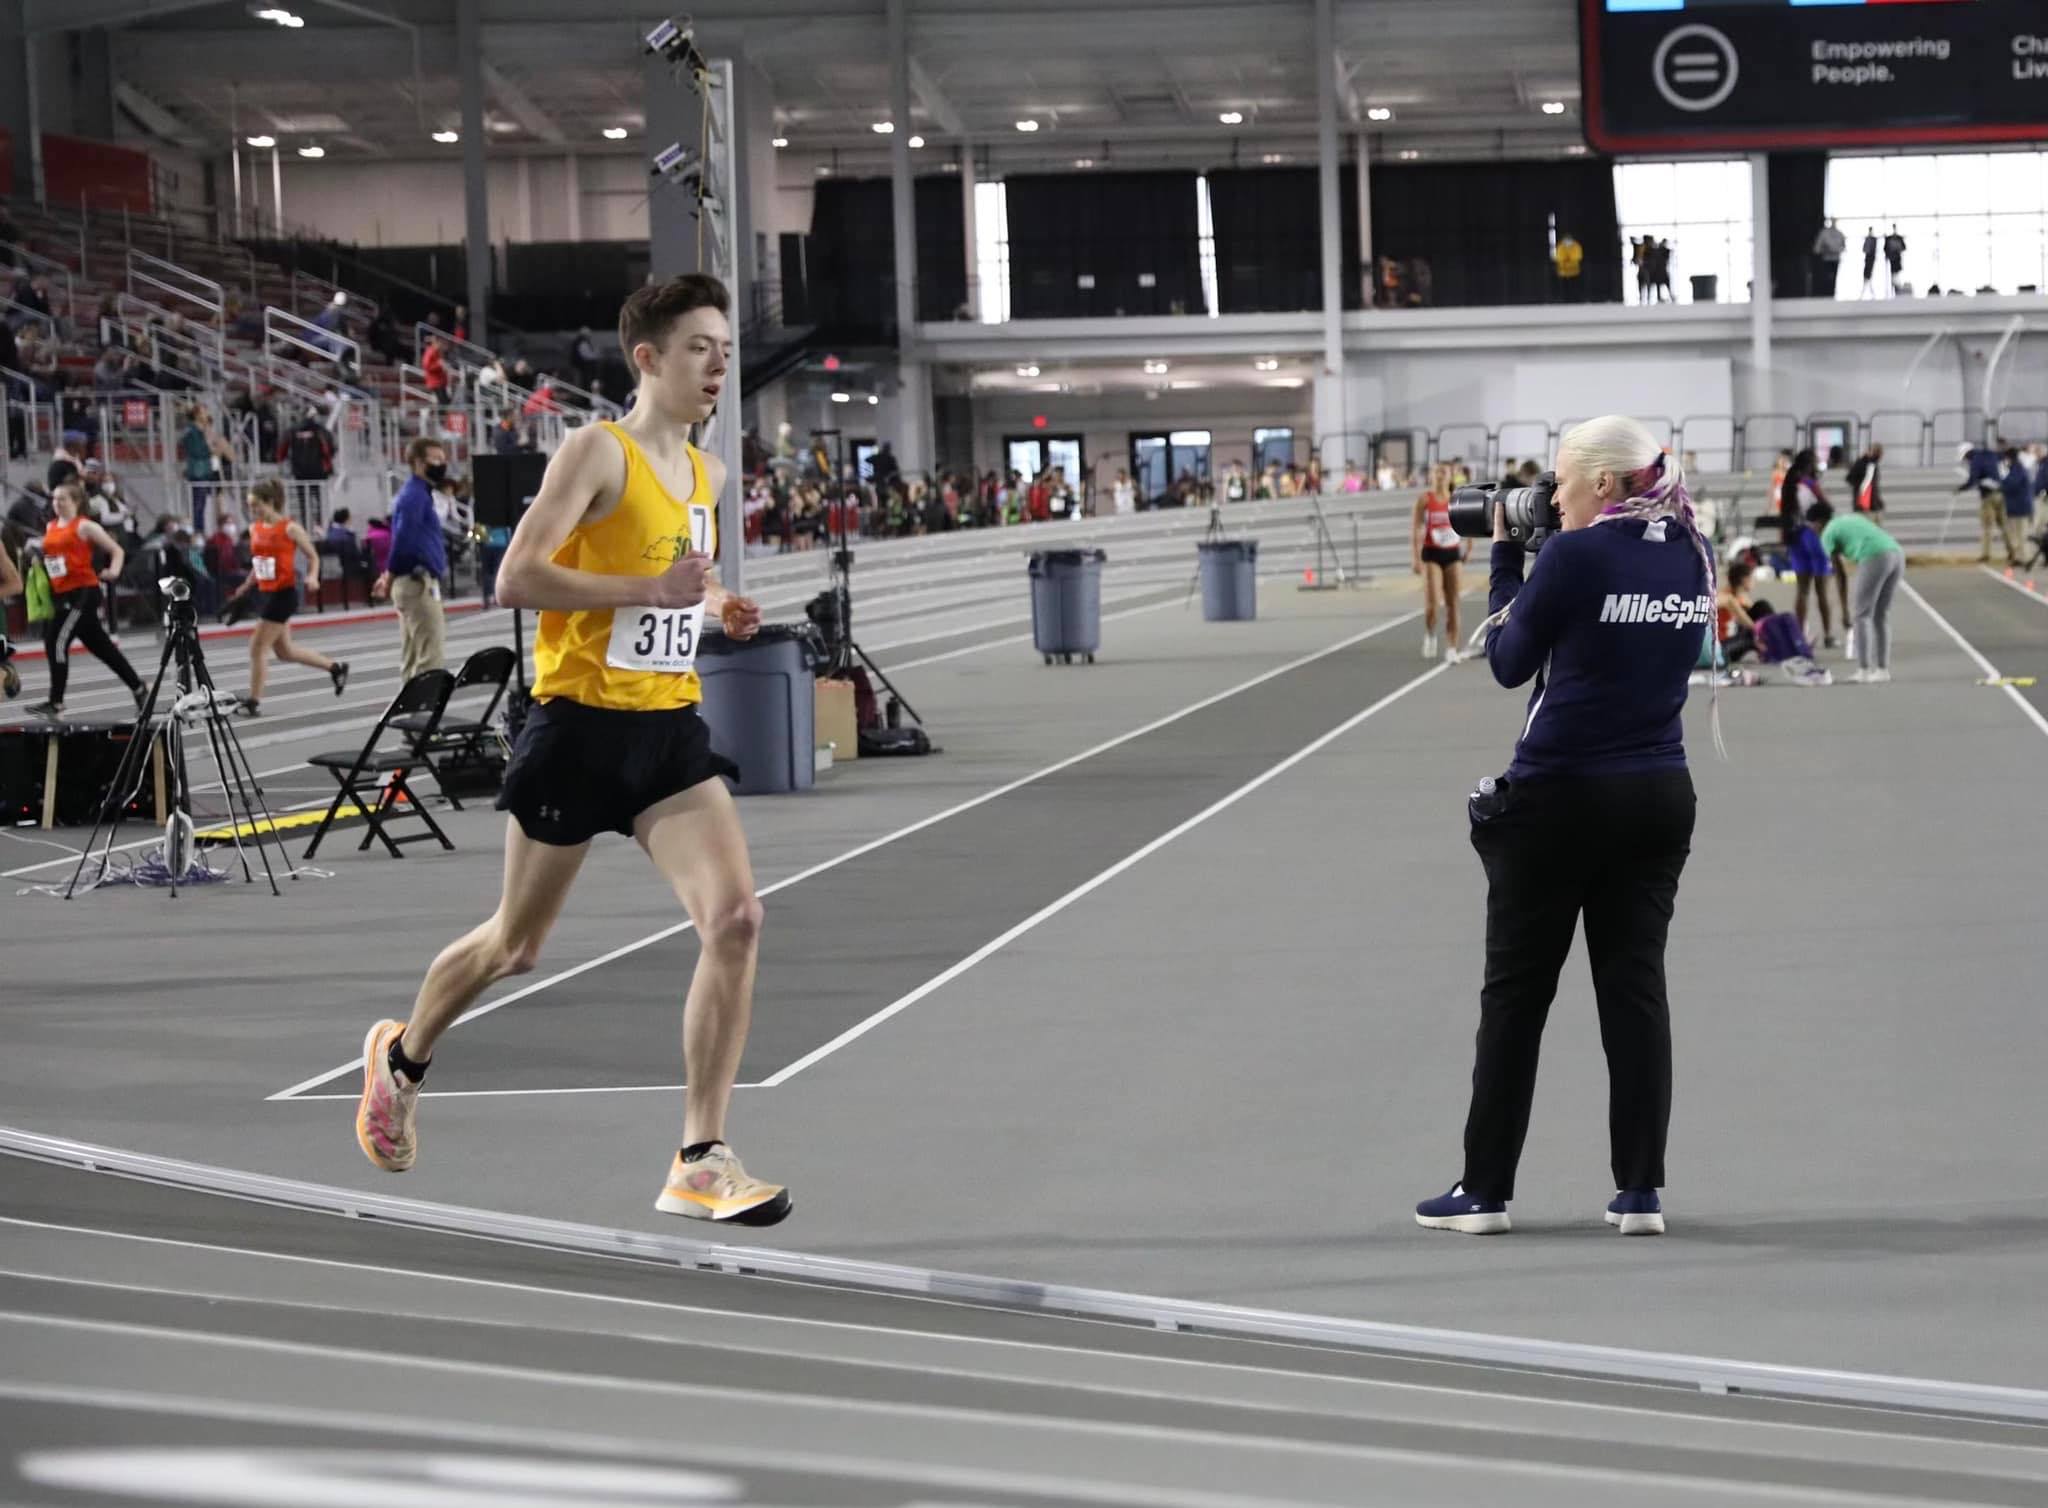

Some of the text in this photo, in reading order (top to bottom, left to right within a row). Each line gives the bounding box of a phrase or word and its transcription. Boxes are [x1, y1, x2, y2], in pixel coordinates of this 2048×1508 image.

[1811, 36, 1951, 61] Empowering
[1811, 61, 1895, 86] People.
[634, 613, 693, 657] 315
